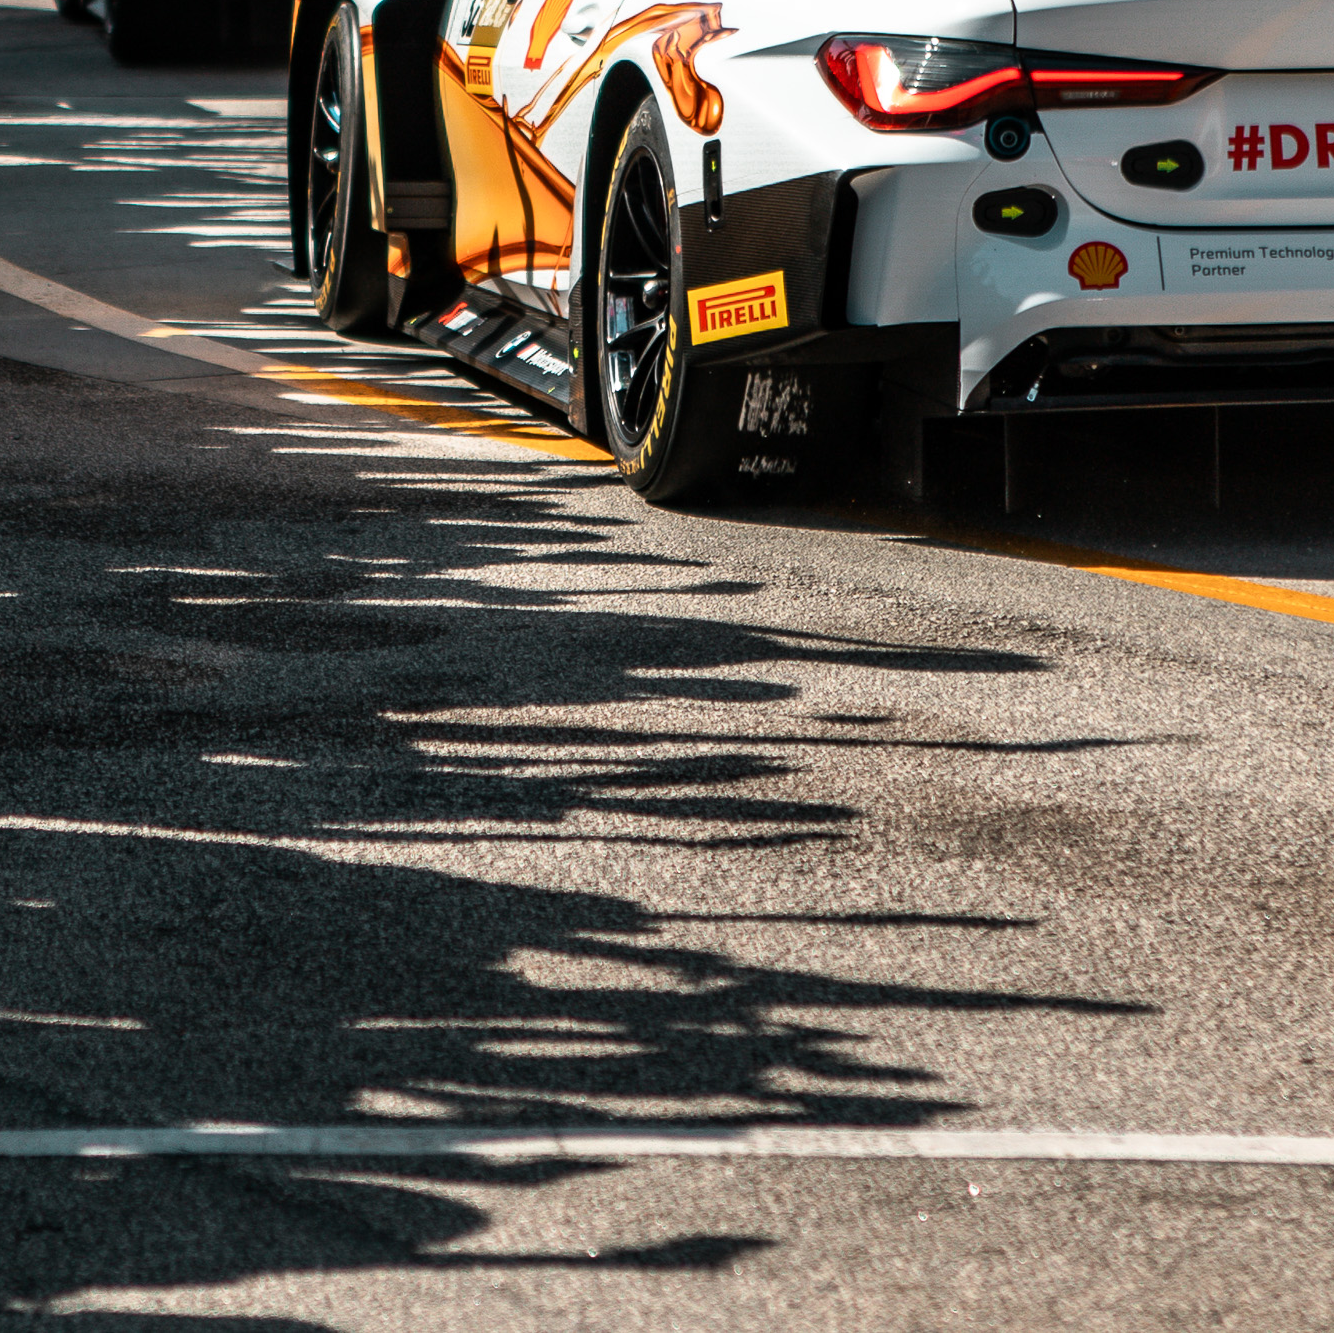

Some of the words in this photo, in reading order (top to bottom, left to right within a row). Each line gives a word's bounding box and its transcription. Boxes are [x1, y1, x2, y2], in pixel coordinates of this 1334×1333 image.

[467, 56, 491, 86] PIRELLI
[1190, 247, 1256, 260] Premium
[1192, 264, 1247, 276] Partner
[697, 285, 777, 333] PIRELLI
